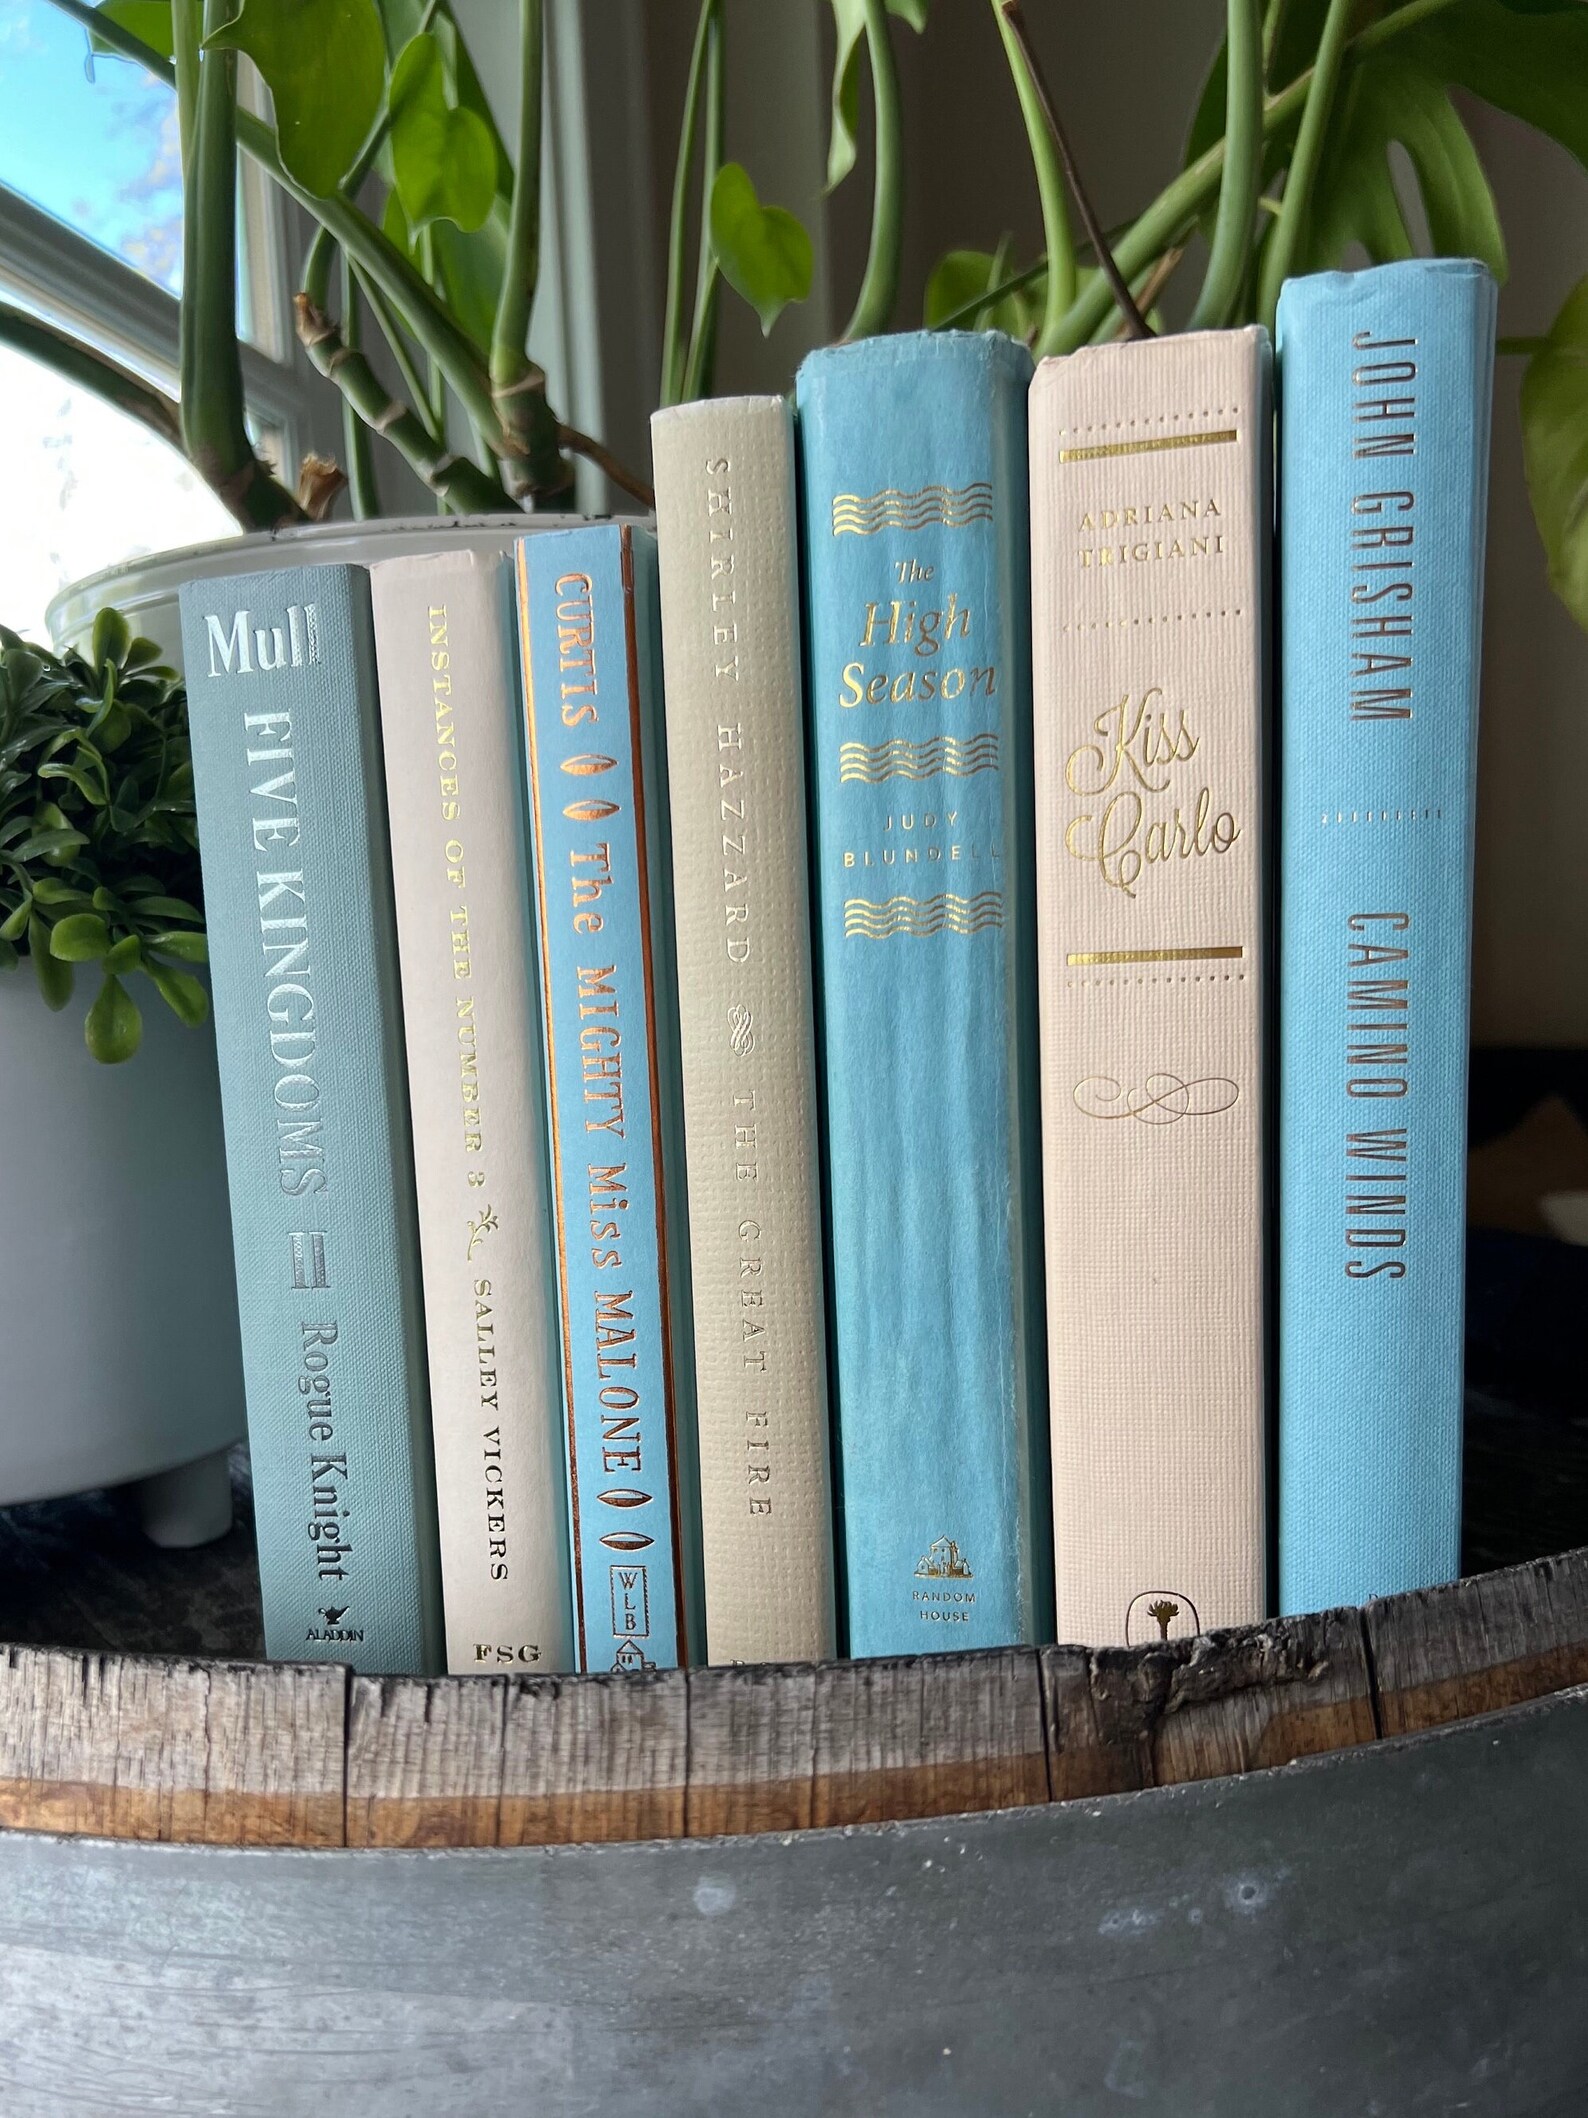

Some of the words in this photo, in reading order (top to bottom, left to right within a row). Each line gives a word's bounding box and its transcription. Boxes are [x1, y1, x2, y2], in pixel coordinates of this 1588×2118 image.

[1351, 331, 1418, 460] JOHN
[705, 457, 739, 682] SHIRLEY
[1077, 498, 1222, 532] ADRIANA
[1077, 535, 1224, 568] TRIGIANI
[858, 592, 971, 656] High
[895, 559, 934, 583] The
[1349, 490, 1416, 723] GRISHAM
[204, 602, 322, 678] Mull
[554, 571, 600, 728] CURTIS
[839, 662, 996, 709] Season
[427, 605, 462, 822] INSTANCES
[1064, 687, 1201, 797] Kiss
[242, 708, 301, 852] FIVE
[883, 811, 958, 832] JUDY
[442, 839, 467, 888] OF
[569, 842, 615, 935] The
[716, 723, 752, 964] HAZZARD
[843, 843, 1000, 868] BLUNDELL
[1064, 787, 1242, 899] Carlo
[449, 905, 474, 980] THE
[256, 868, 328, 1197] KINGDOMS
[576, 964, 626, 1139] MIGHTY
[1345, 911, 1410, 1099] CAMINO
[456, 996, 483, 1153] NUMBER
[467, 1171, 485, 1188] 3
[733, 1090, 758, 1181] THE
[1344, 1127, 1407, 1280] WINDS
[472, 1279, 500, 1412] SALLEY
[738, 1219, 767, 1372] GREAT
[297, 1319, 338, 1442] Rogue
[594, 1289, 641, 1474] MALONE
[308, 1452, 352, 1581] Knight
[482, 1426, 508, 1581] VICKERS
[744, 1410, 771, 1516] FIRE
[306, 1628, 364, 1642] ALADDIN
[911, 1590, 977, 1604] RANDOM
[919, 1609, 970, 1622] HOUSE
[474, 1643, 541, 1664] FSG
